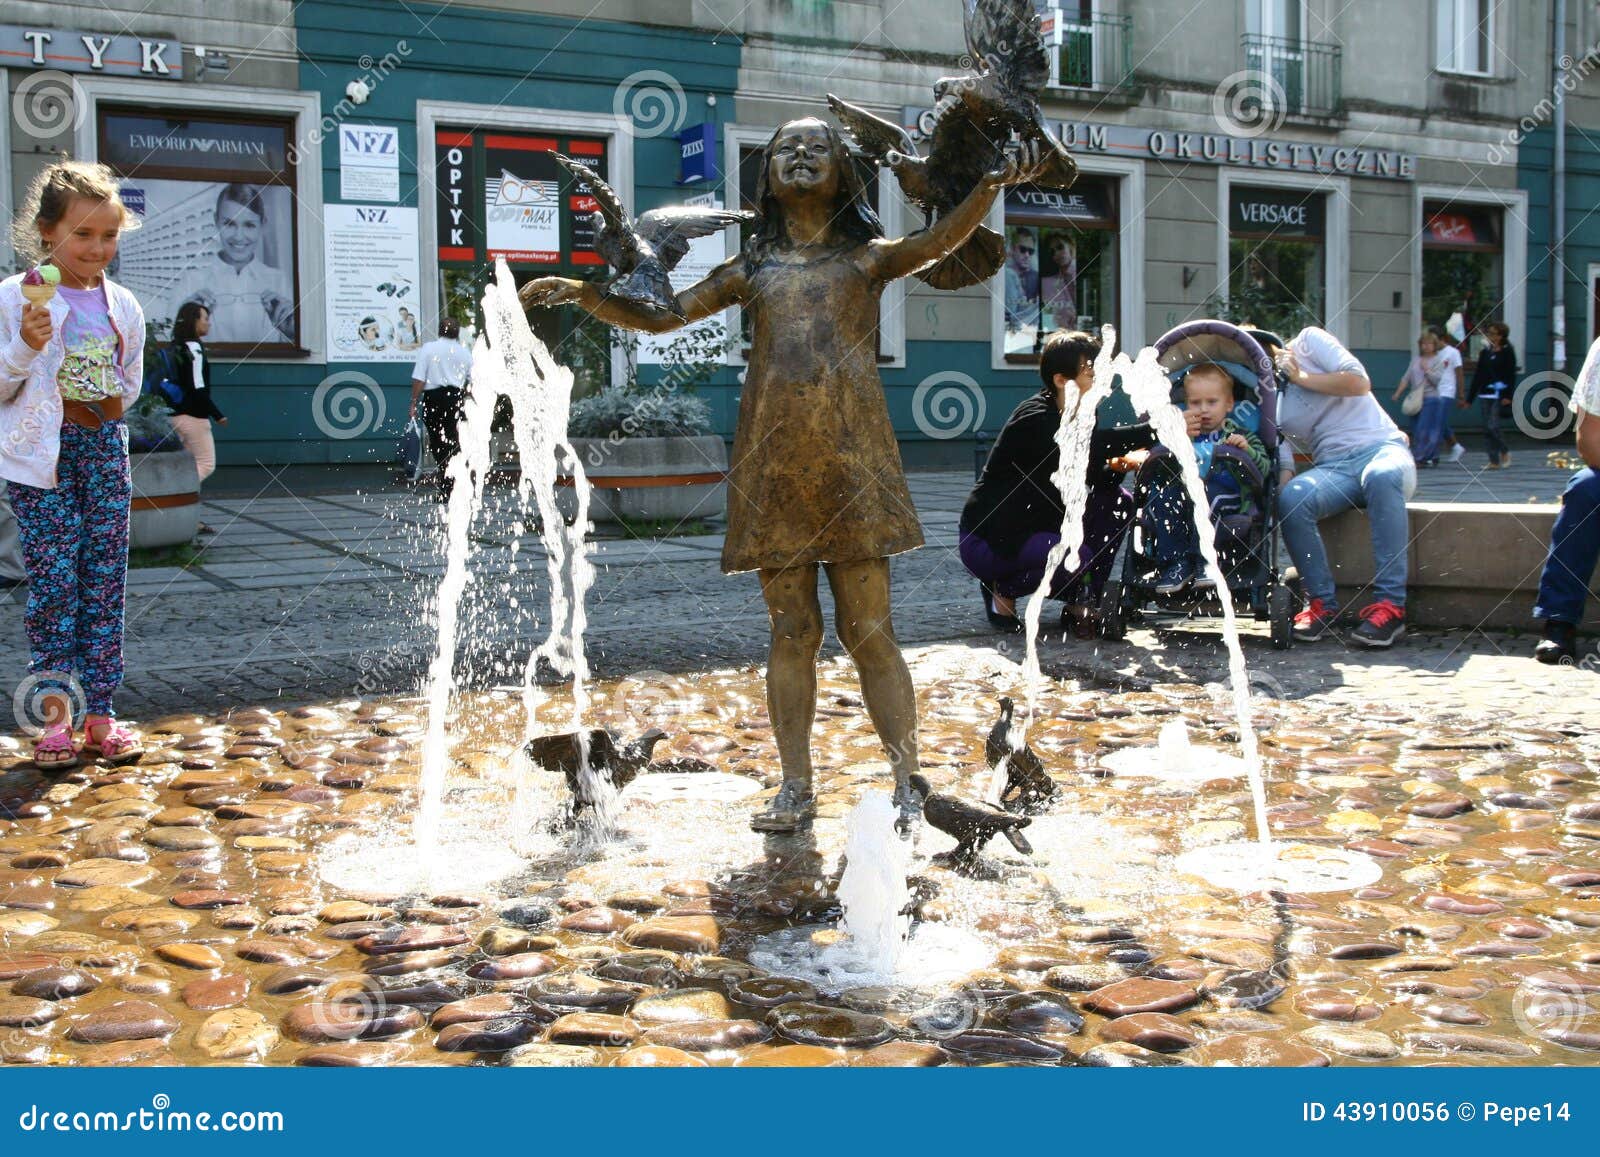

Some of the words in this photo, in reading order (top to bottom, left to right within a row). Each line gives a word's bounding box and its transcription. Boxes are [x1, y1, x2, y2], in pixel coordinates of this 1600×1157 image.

[129, 134, 193, 151] EMPORIO
[213, 139, 265, 155] ARMANI
[344, 130, 396, 154] NFZ
[682, 139, 704, 158] ZEISS
[1149, 131, 1412, 177] OKULISTYCZNE
[448, 148, 463, 245] OPTYK
[1016, 191, 1087, 208] VOGUE
[355, 207, 388, 223] NFZ
[1240, 203, 1307, 226] VERSACE
